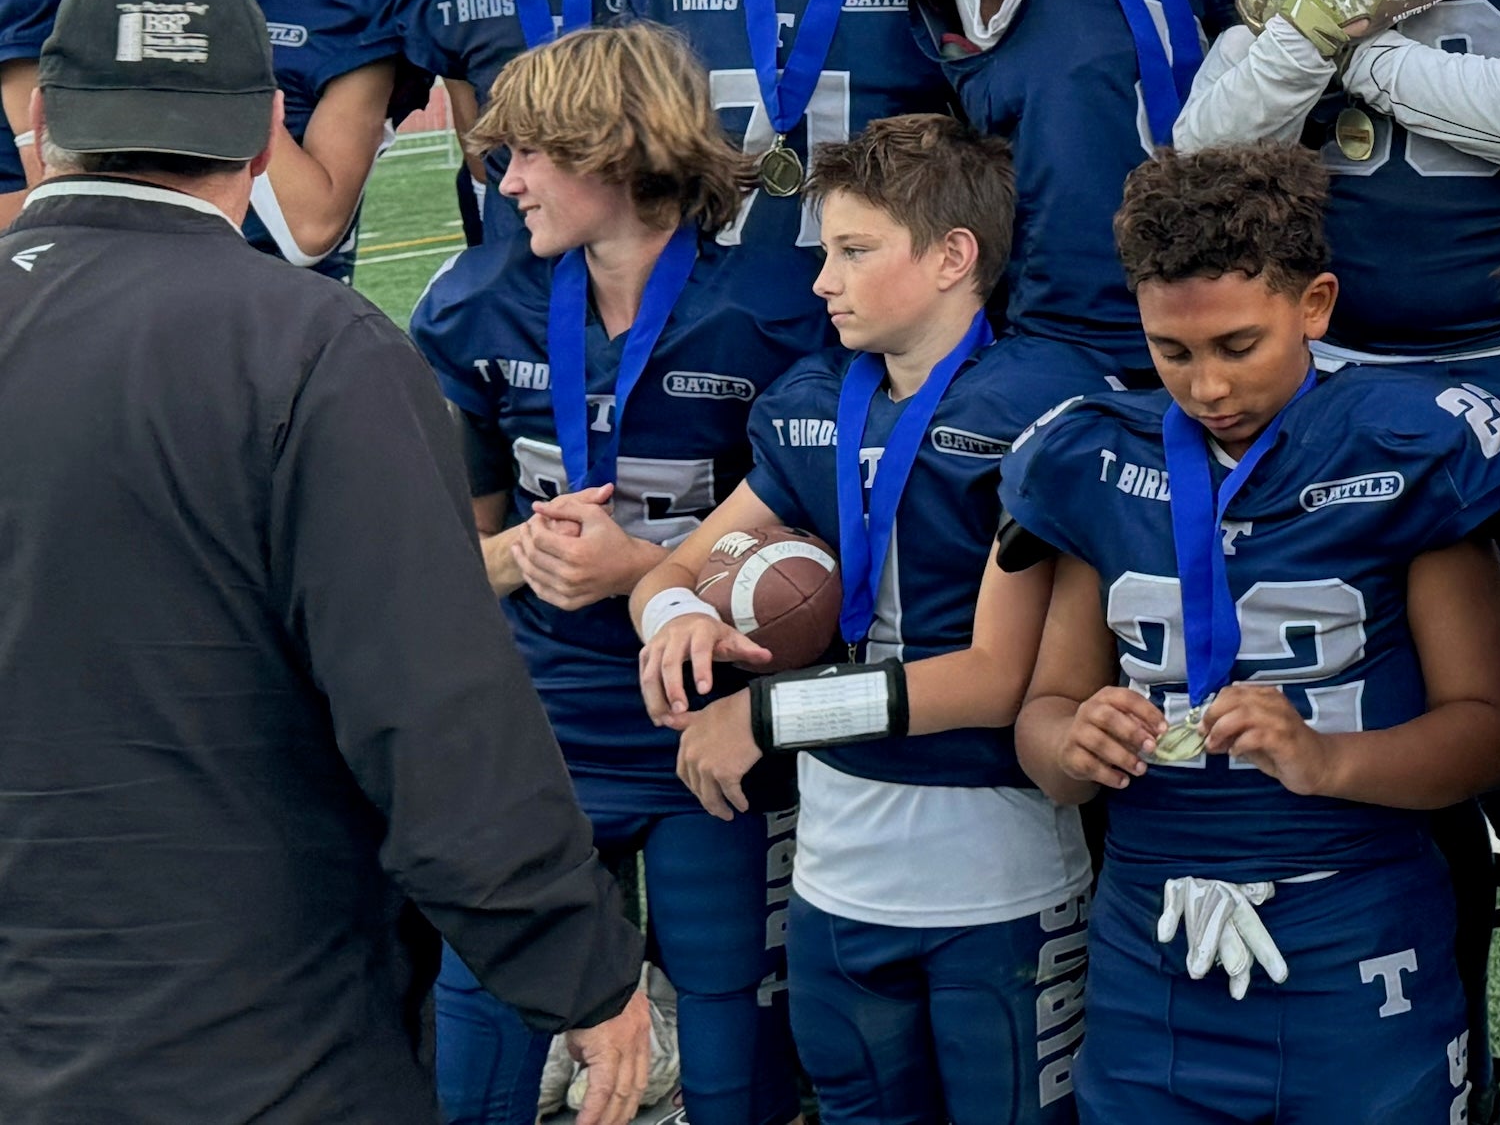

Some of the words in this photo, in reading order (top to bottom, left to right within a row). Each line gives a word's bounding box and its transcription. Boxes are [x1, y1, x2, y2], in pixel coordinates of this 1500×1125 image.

[437, 1, 451, 26] T
[267, 28, 300, 42] TLE
[709, 68, 851, 247] 71
[496, 359, 552, 391] IRD
[671, 376, 747, 397] BATTLE
[585, 393, 617, 433] T
[772, 419, 786, 447] T
[1100, 450, 1117, 482] T
[1117, 465, 1171, 502] BIRD
[1310, 477, 1398, 508] BATTLE
[1220, 521, 1253, 556] T
[1107, 570, 1367, 770] 22
[1359, 948, 1418, 1018] T
